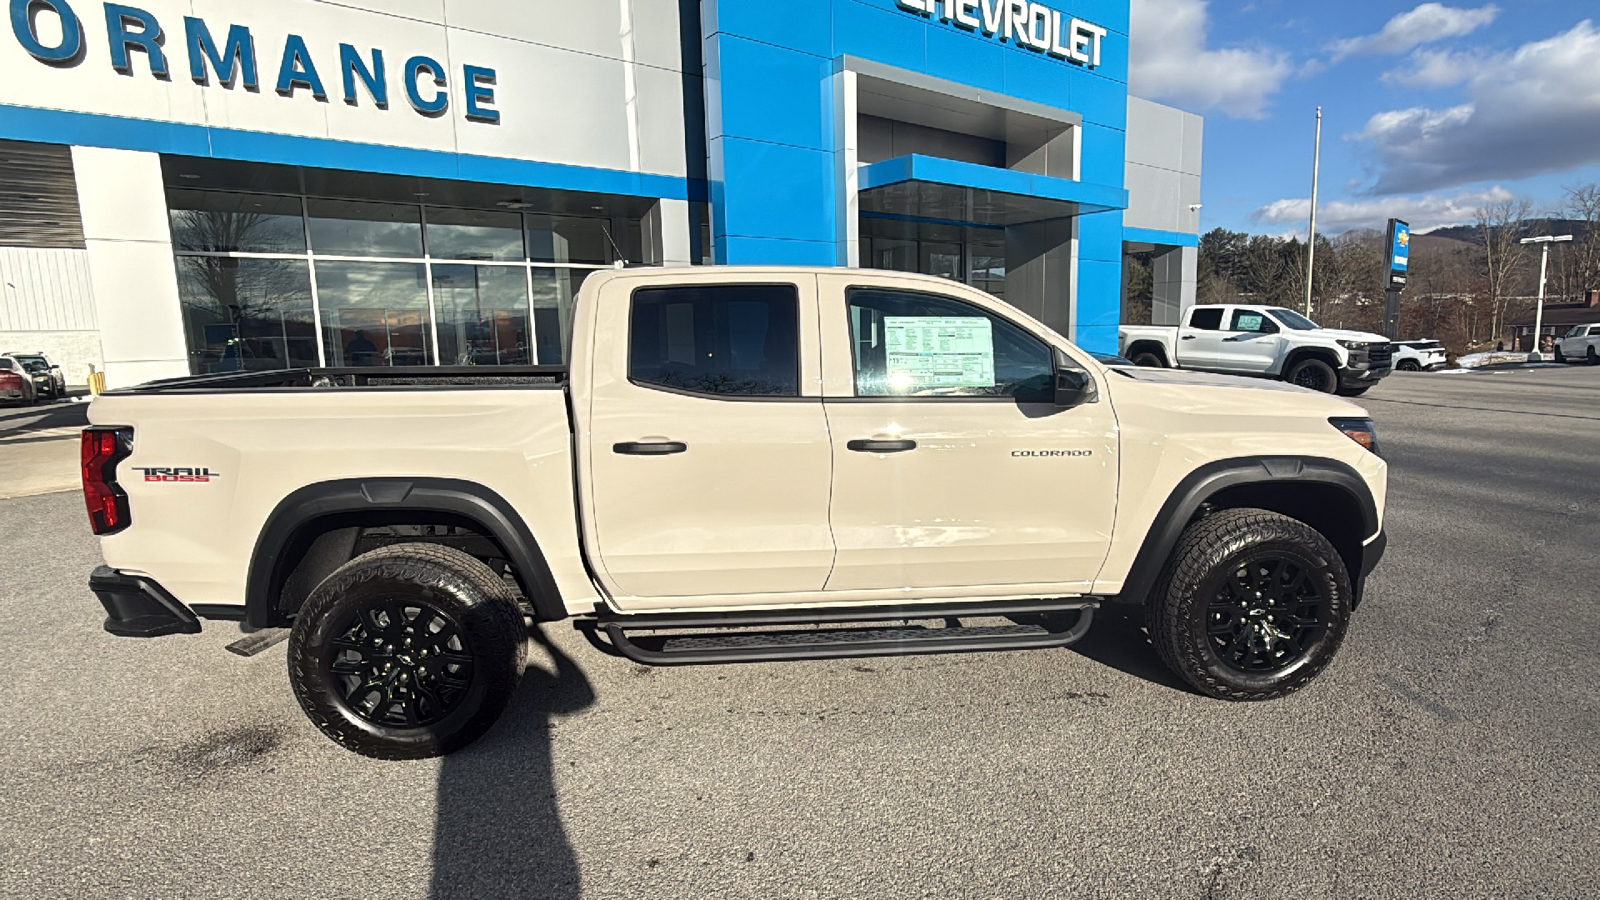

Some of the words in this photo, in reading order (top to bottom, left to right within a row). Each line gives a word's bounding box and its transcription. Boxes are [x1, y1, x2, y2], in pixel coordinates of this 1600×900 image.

[898, 0, 1107, 67] EVROLET
[131, 467, 220, 476] TRAIL
[144, 474, 210, 482] BOSS
